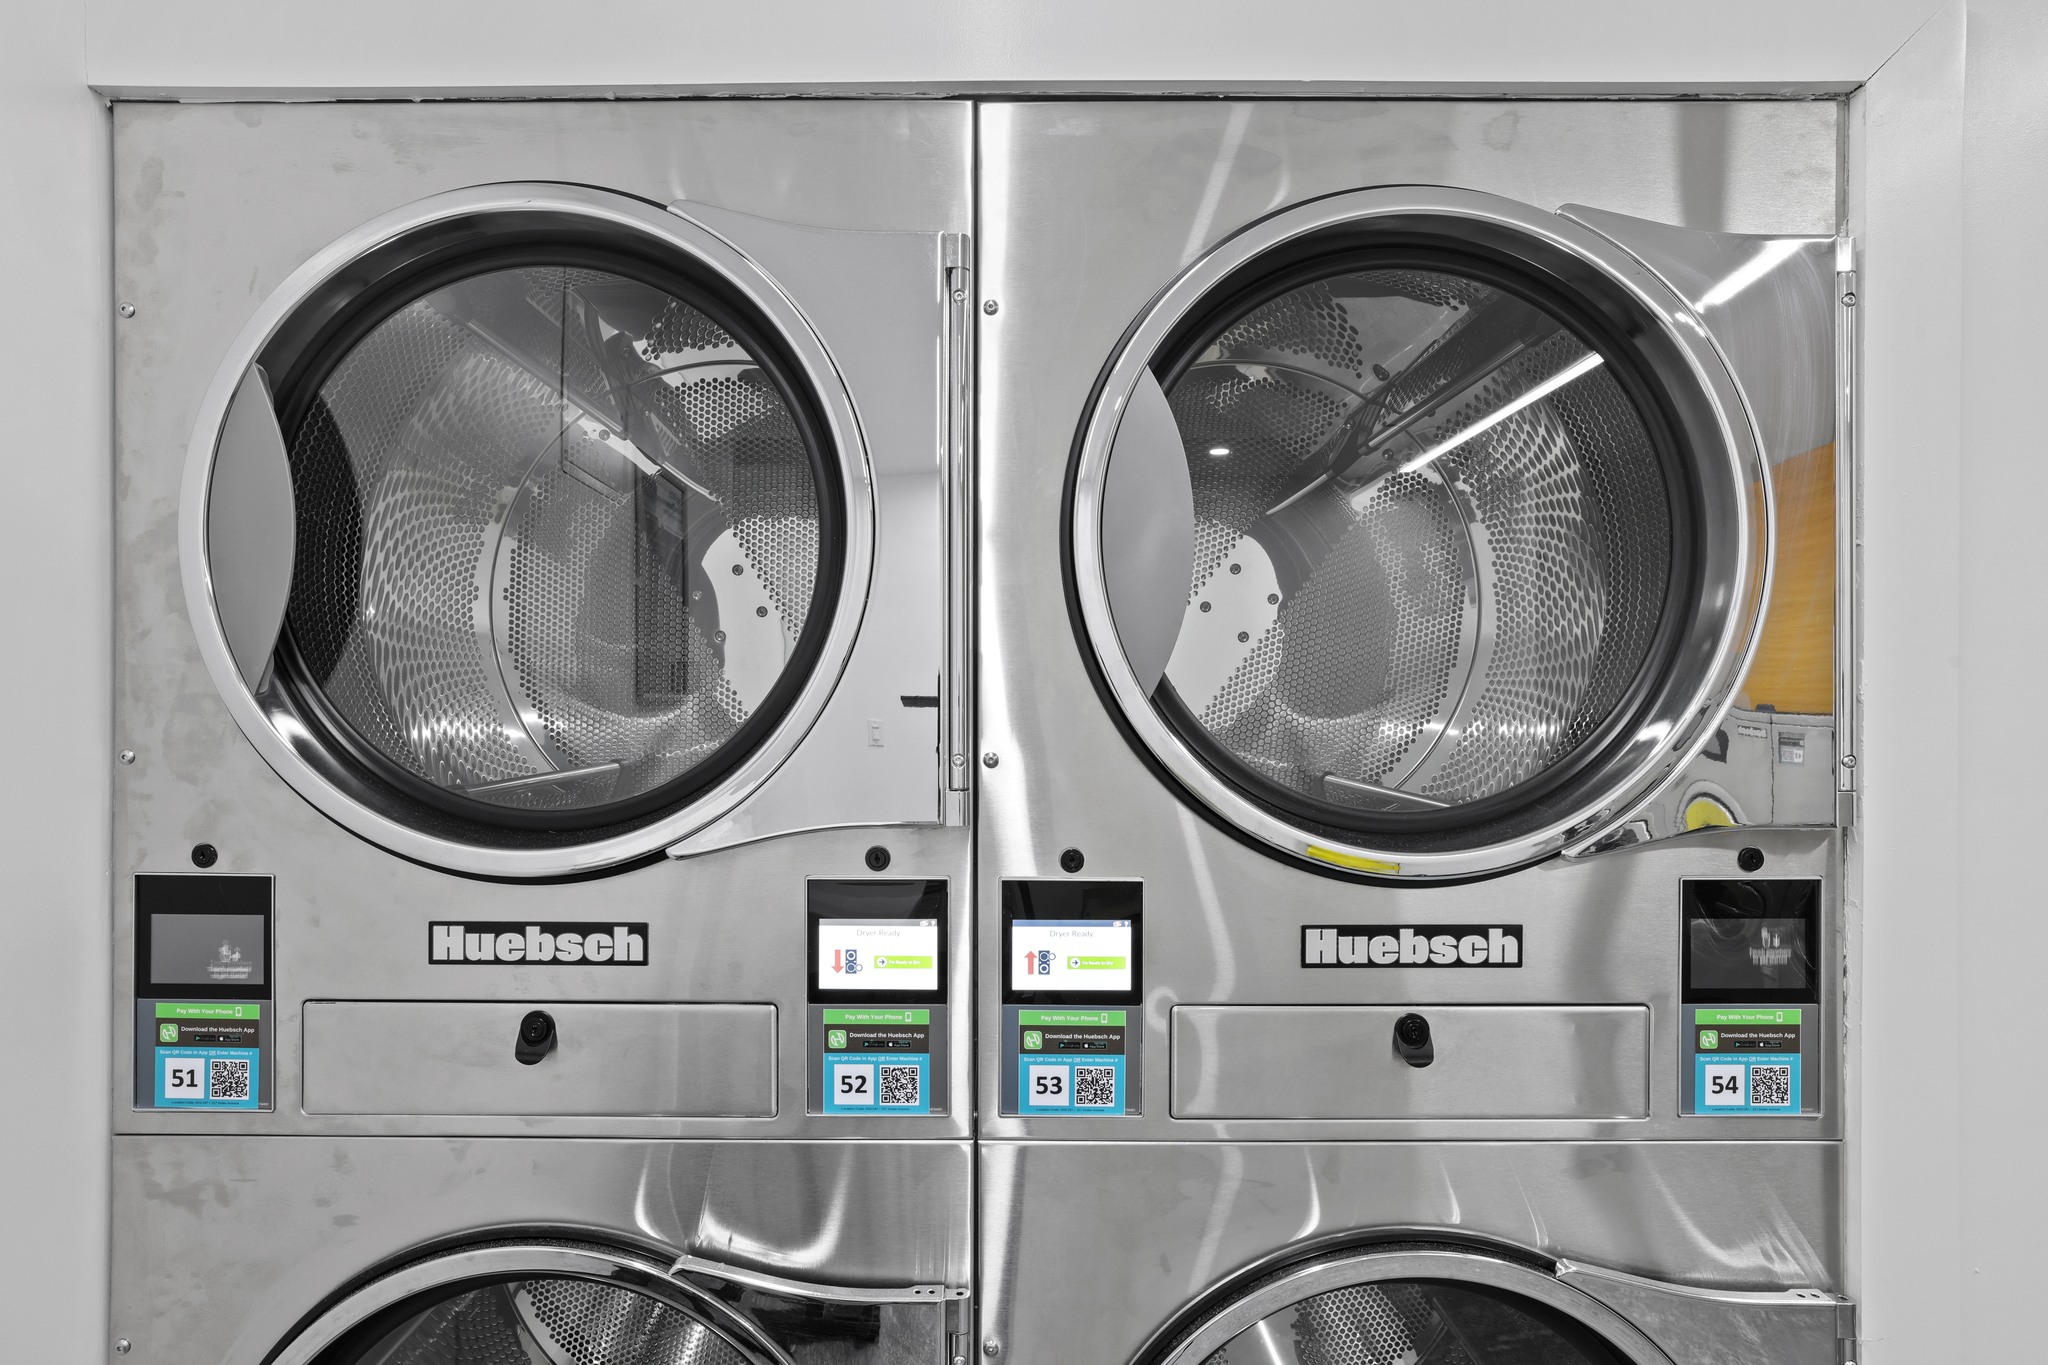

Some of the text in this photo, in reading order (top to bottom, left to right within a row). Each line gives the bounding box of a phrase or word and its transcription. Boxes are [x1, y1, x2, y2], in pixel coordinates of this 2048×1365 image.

[879, 929, 900, 937] Ready
[1050, 930, 1094, 938] Dryer Ready
[433, 925, 643, 962] Huebsch
[1305, 928, 1518, 964] Huebsch
[171, 1069, 198, 1087] 51
[841, 1075, 867, 1094] 52
[1036, 1076, 1063, 1094] 53
[1712, 1075, 1739, 1094] 54
